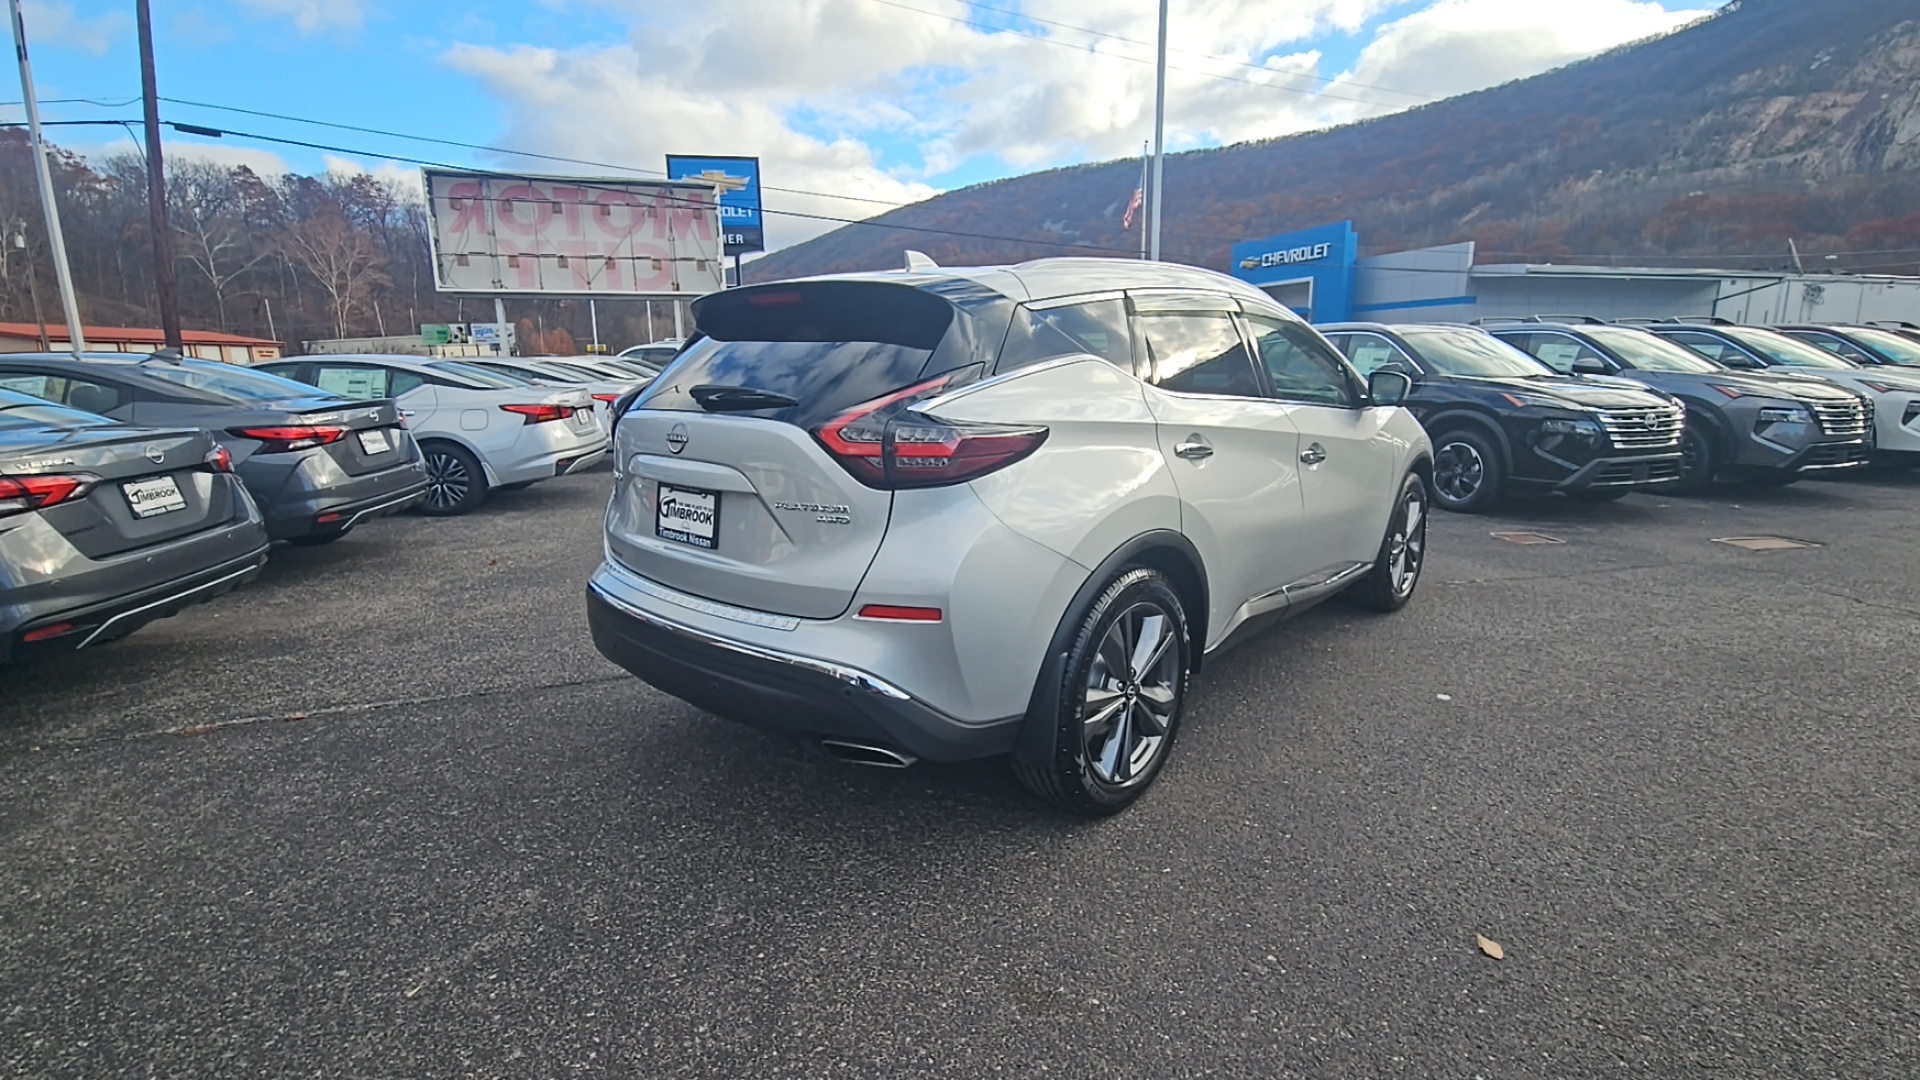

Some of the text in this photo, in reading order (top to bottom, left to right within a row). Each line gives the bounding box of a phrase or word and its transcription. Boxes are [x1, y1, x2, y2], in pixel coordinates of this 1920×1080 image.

[1261, 242, 1331, 267] CHEVROLET
[15, 457, 75, 470] VERSA
[660, 496, 713, 526] TIMBROOK
[659, 527, 711, 548] Timbrook Nissan
